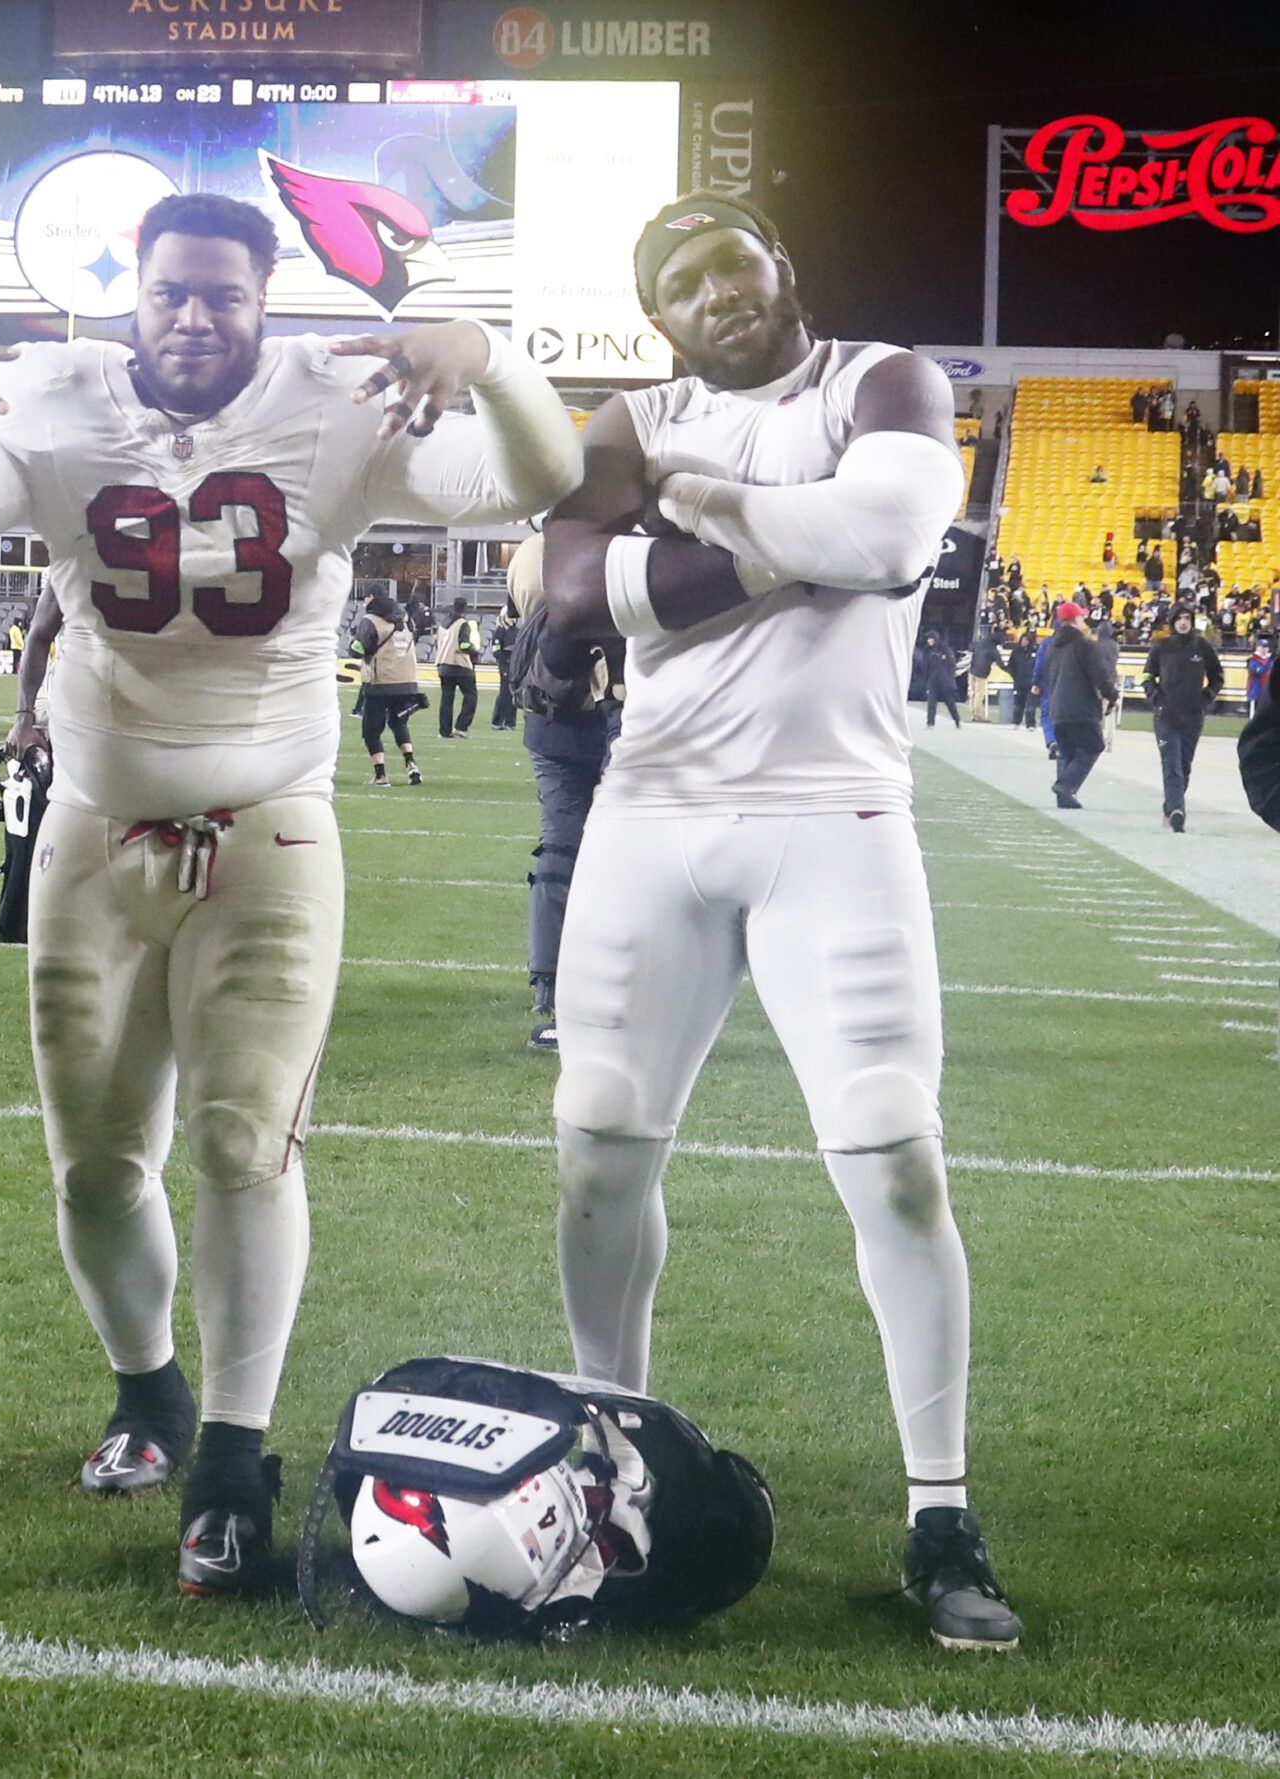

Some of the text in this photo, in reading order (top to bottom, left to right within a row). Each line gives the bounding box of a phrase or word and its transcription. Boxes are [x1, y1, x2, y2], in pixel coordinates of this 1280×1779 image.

[168, 21, 296, 41] STADIUM
[500, 20, 712, 56] 84 LUMBER
[256, 83, 338, 102] 4TH 0:00
[692, 101, 703, 130] LIFE
[45, 223, 101, 239] Steelers
[576, 332, 658, 363] PNC
[85, 470, 294, 637] 93
[932, 577, 960, 590] Steel
[376, 1409, 507, 1451] DOUGLAS
[537, 1503, 558, 1531] 4
